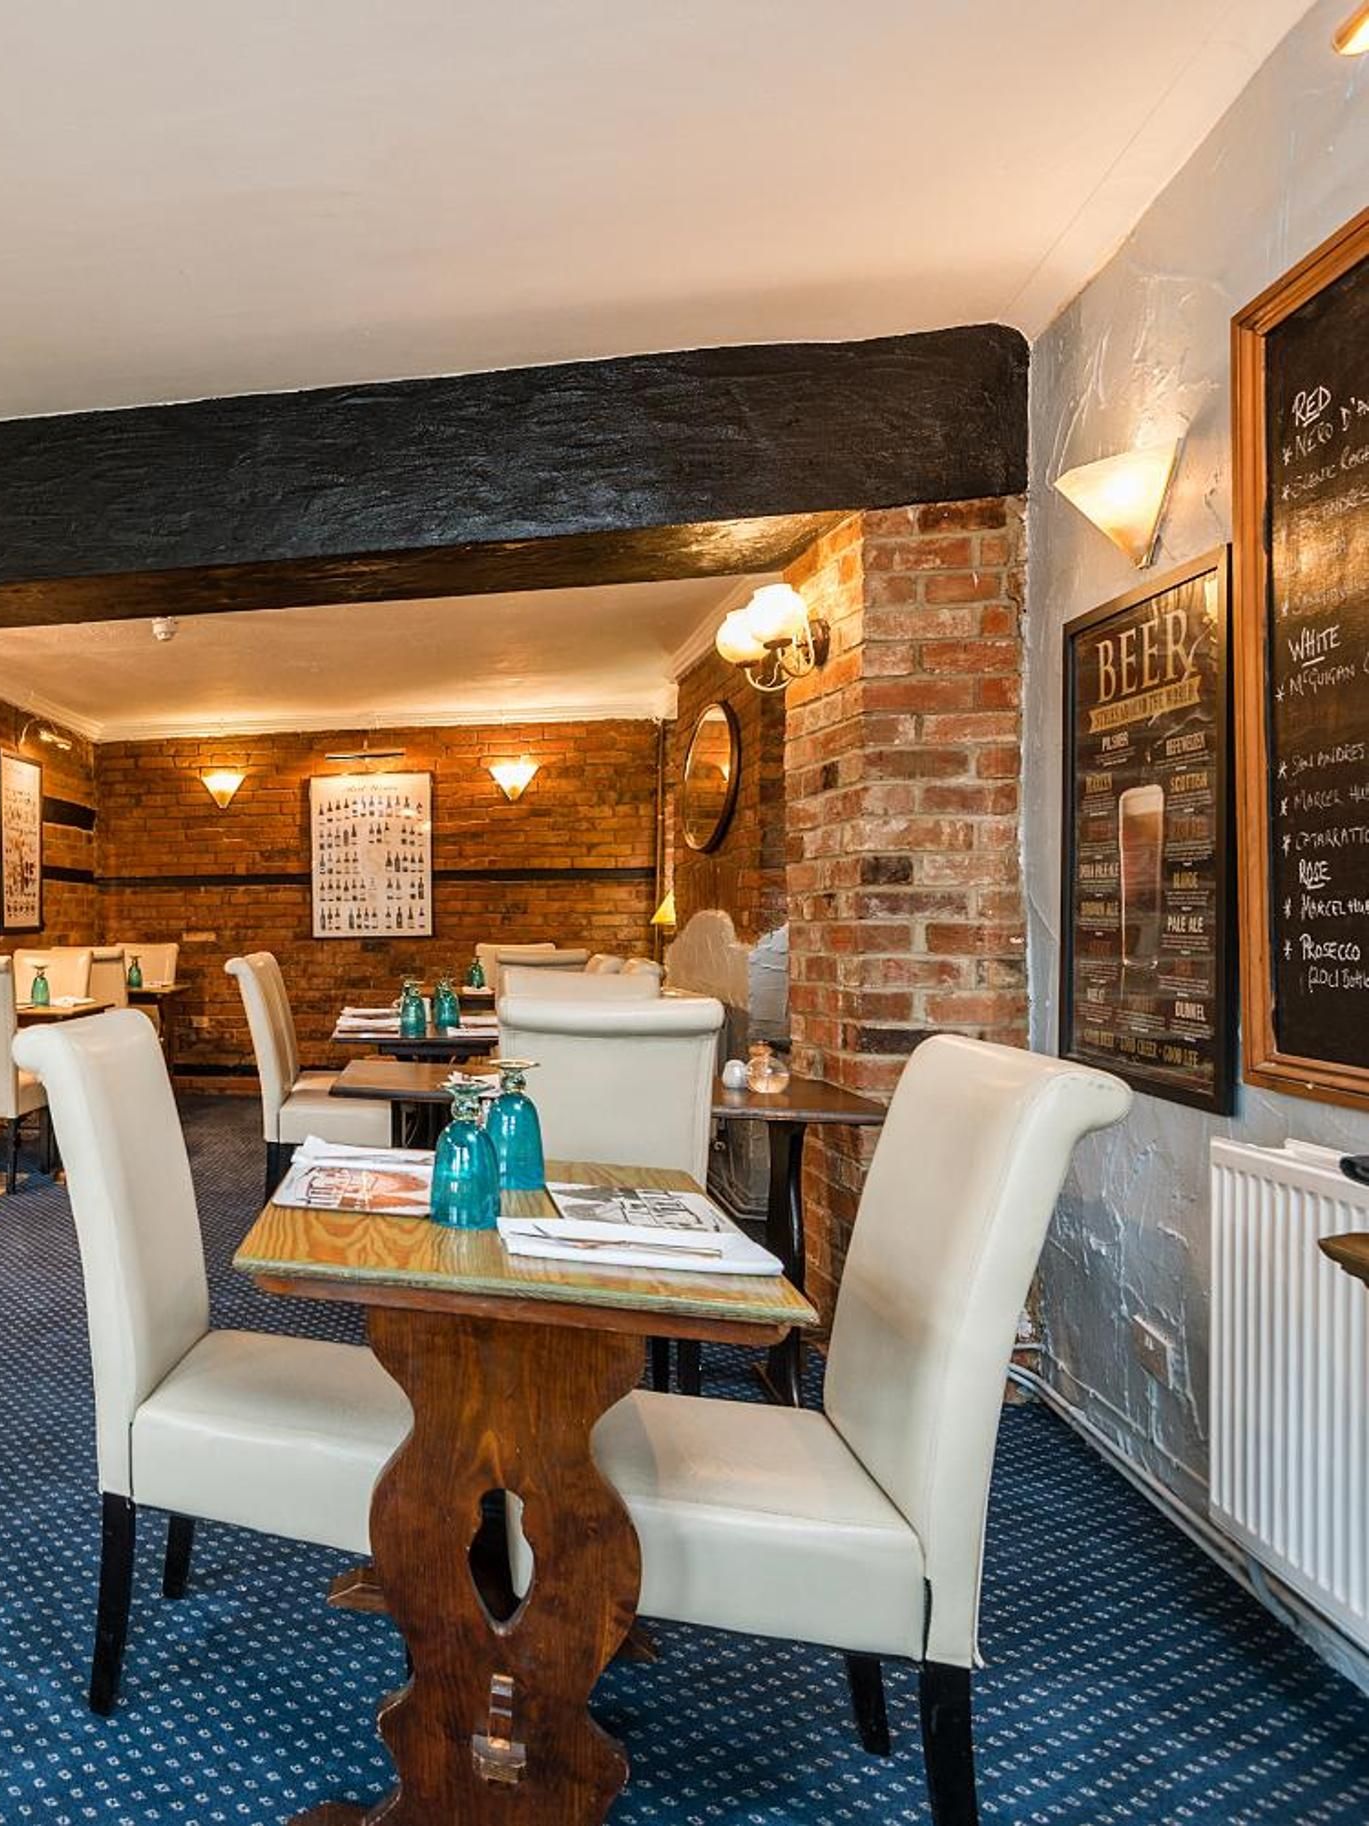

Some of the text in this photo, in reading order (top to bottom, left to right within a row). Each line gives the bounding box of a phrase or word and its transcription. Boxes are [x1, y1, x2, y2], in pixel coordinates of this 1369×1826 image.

[1292, 385, 1332, 427] RED
[1095, 608, 1198, 703] BEER
[1288, 624, 1341, 662] WHITE
[1299, 858, 1331, 886] ROSE
[1167, 915, 1203, 933] PALE ALE
[1299, 933, 1361, 961] PROSECCO
